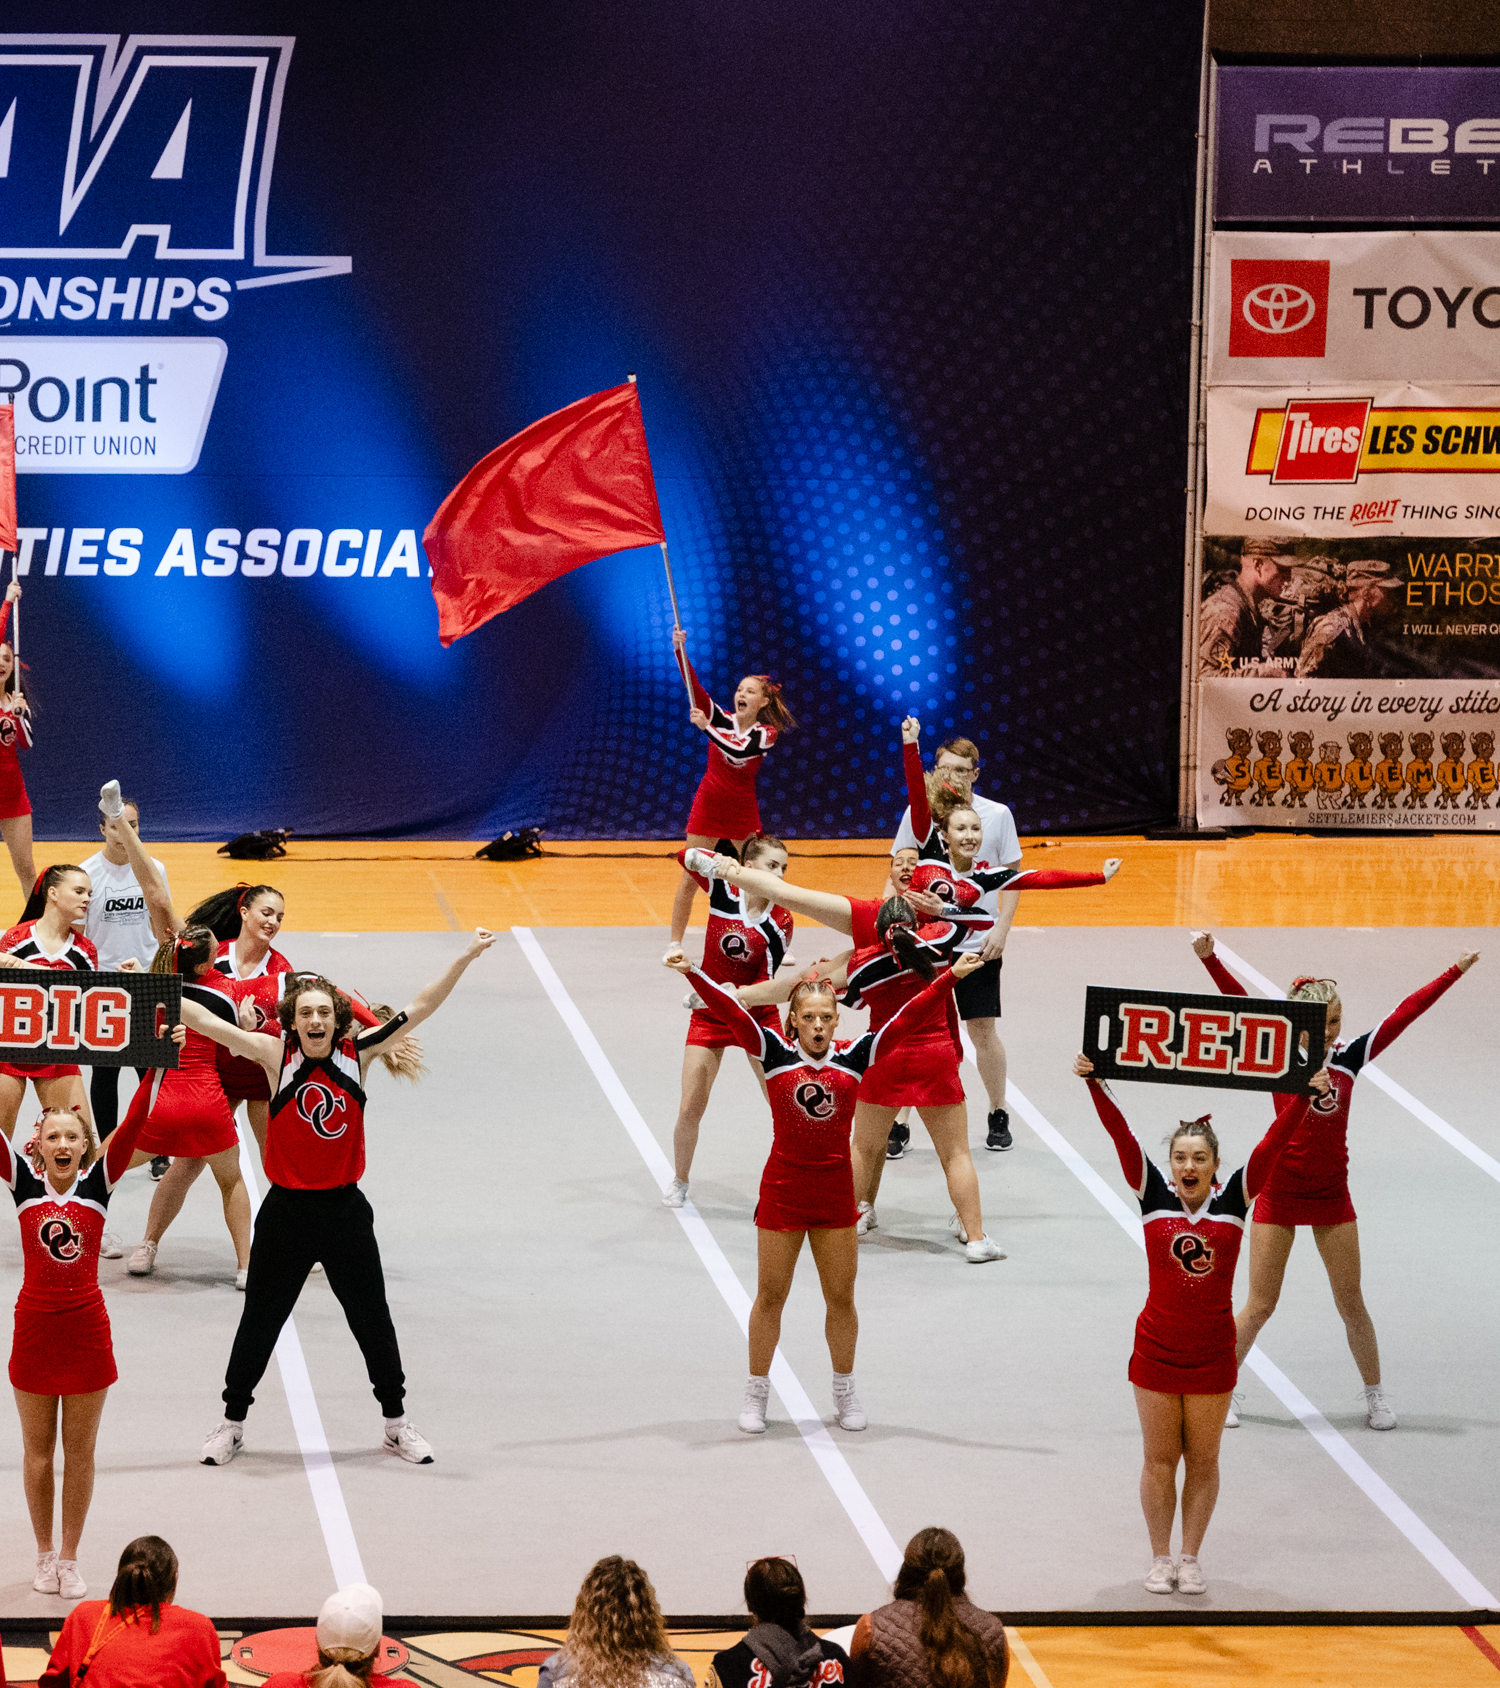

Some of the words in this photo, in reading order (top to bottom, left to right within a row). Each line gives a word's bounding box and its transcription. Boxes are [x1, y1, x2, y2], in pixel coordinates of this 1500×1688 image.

[1253, 159, 1495, 175] ATHLET
[1353, 286, 1500, 329] TOYO
[15, 435, 86, 456] CREDIT
[94, 435, 157, 456] UNION
[1287, 412, 1361, 461] Tires
[1368, 425, 1417, 455] LES
[1422, 425, 1500, 455] SCHW
[1245, 506, 1305, 521] DOING
[1312, 506, 1347, 521] THE
[1350, 499, 1401, 522] RIGHT
[1402, 505, 1457, 520] THING
[154, 528, 434, 578] ASSOCIA
[1402, 624, 1409, 635] I
[1411, 624, 1443, 635] WILL
[1445, 623, 1488, 635] NEVER
[1265, 656, 1302, 669] ARMY
[1250, 688, 1283, 712] A
[1286, 689, 1346, 722] story
[1350, 690, 1373, 713] in
[1377, 695, 1444, 722] every
[105, 897, 144, 912] OSAA
[1115, 1002, 1293, 1079] RED
[295, 1081, 348, 1140] OC
[794, 1081, 837, 1121] OC
[38, 1217, 83, 1264] OC
[1170, 1232, 1216, 1278] OC
